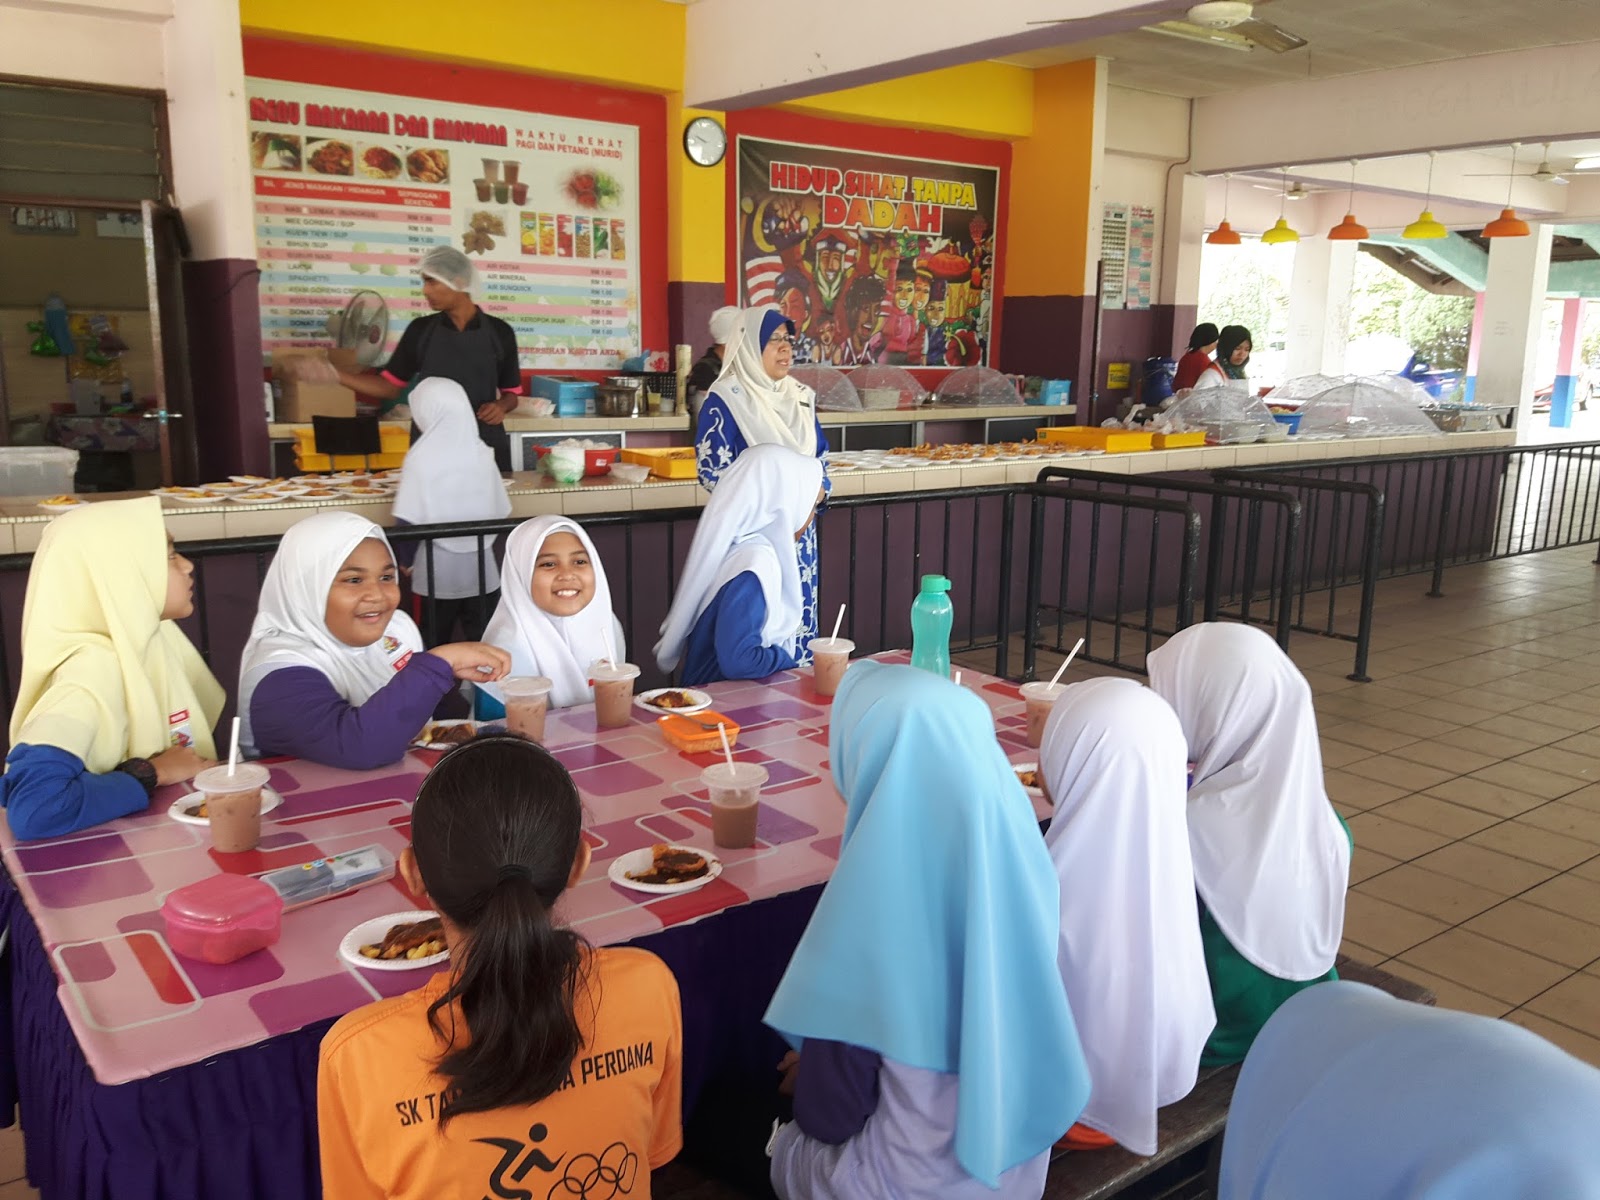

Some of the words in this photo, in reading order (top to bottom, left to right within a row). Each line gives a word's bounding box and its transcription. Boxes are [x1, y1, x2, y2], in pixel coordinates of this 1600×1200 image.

[394, 113, 429, 139] DAN
[515, 128, 566, 142] WAKTU
[577, 136, 623, 148] REHAT
[515, 139, 536, 149] PAGI
[537, 142, 555, 151] DAN
[557, 144, 590, 155] PETANG
[591, 148, 623, 160] (MURID)
[769, 161, 842, 196] HIDUP
[843, 170, 908, 201] SIHAT
[911, 177, 978, 210] TANPA
[303, 219, 335, 227] GORENG
[822, 195, 945, 236] DADAH
[395, 1098, 423, 1127] SK
[580, 1039, 655, 1085] PERDANA
